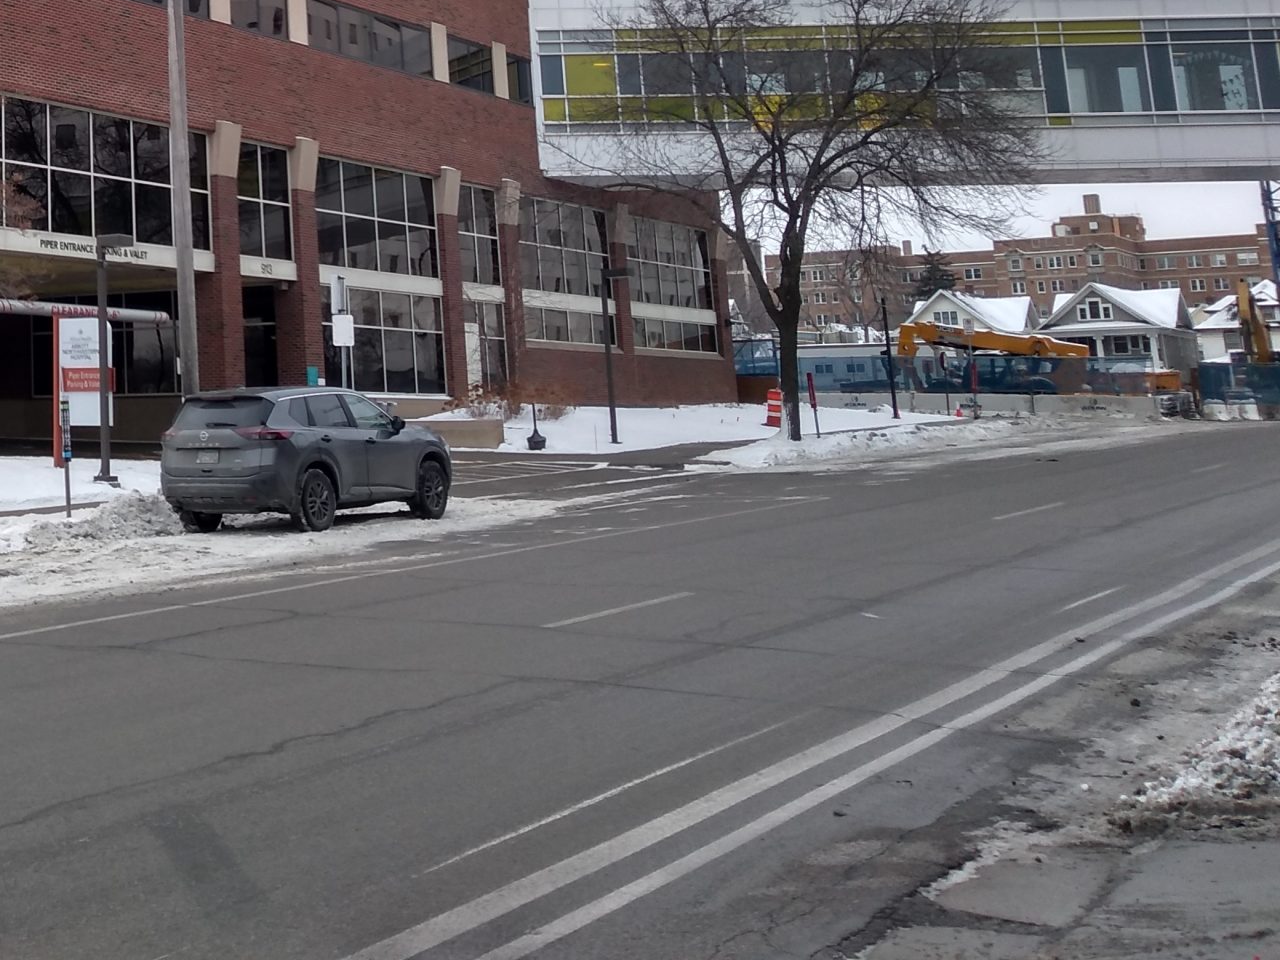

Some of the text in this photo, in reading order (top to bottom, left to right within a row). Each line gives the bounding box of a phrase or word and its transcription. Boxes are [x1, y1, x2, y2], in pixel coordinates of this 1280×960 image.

[40, 239, 58, 250] PIPER
[60, 241, 94, 254] ENTRANCE
[130, 249, 148, 260] VALET
